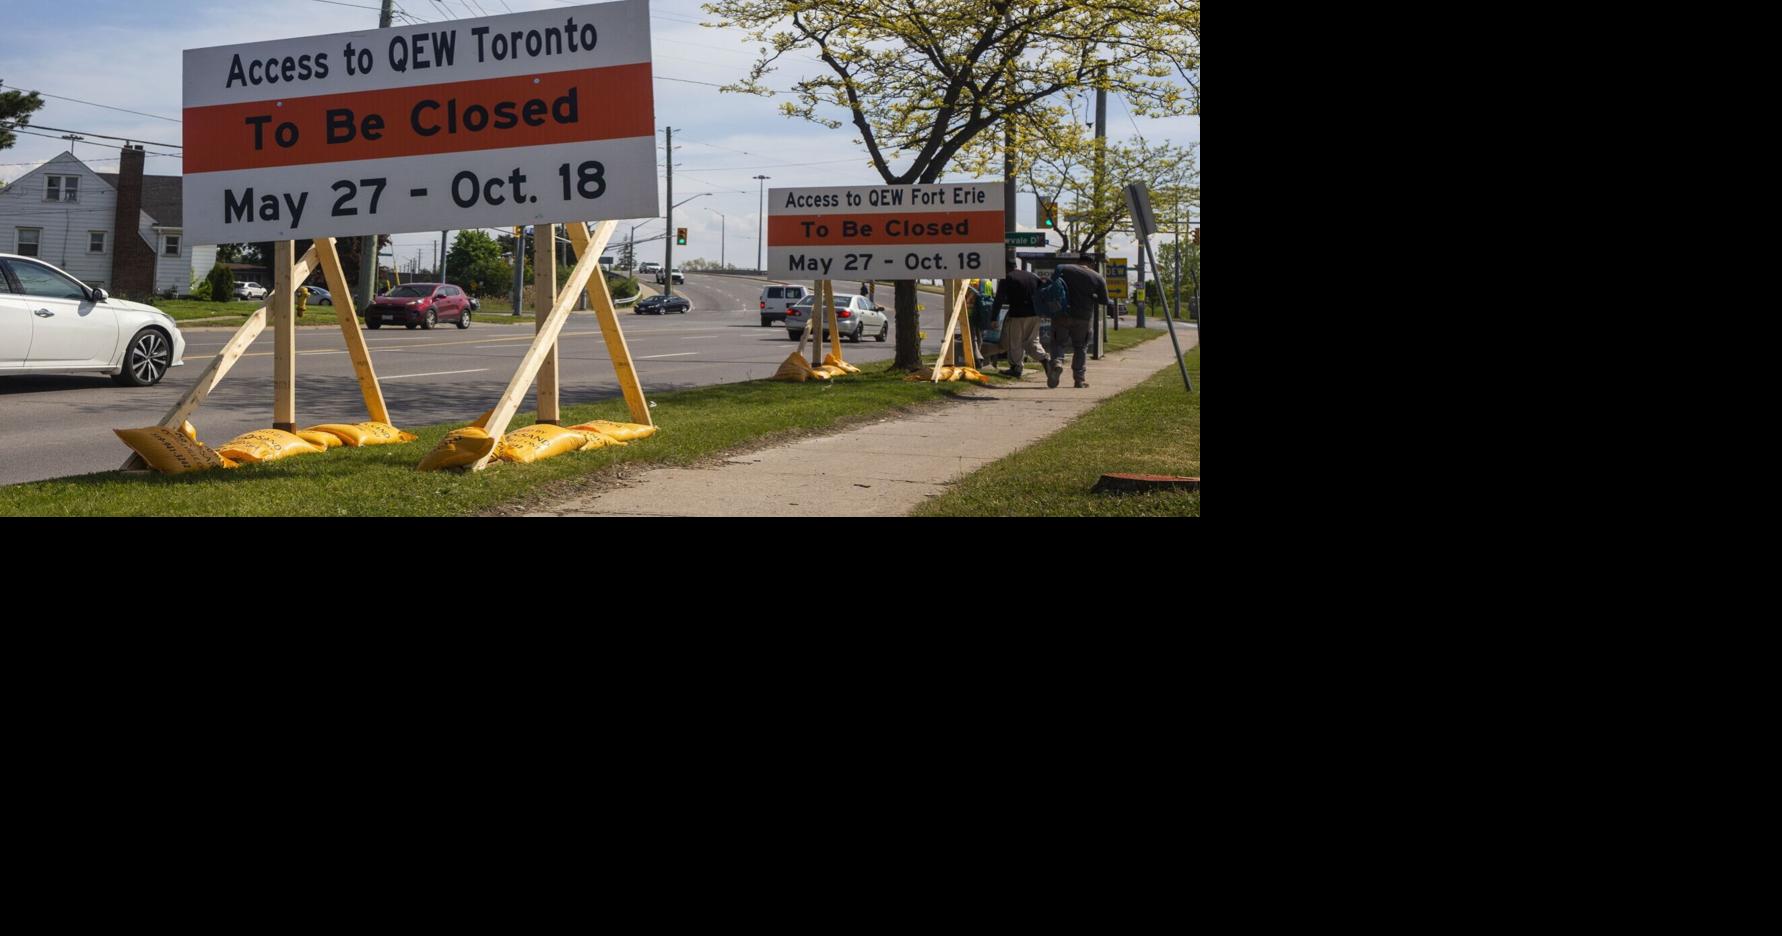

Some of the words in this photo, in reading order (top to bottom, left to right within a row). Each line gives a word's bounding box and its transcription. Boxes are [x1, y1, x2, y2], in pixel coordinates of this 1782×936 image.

[225, 52, 329, 89] Access
[343, 41, 374, 76] to
[388, 29, 457, 74] QEW
[471, 16, 598, 63] Toronto
[245, 115, 301, 152] To
[325, 106, 386, 145] Be
[409, 86, 580, 138] Closed
[224, 187, 309, 230] May
[330, 176, 387, 217] 27
[410, 187, 428, 197] -
[451, 167, 537, 209] Oct.
[559, 160, 606, 201] 18
[785, 191, 839, 208] Access
[846, 190, 862, 207] to
[869, 188, 904, 207] QEW
[911, 188, 945, 205] Fort
[953, 187, 986, 204] Erie
[801, 220, 829, 239] To
[842, 219, 873, 238] Be
[884, 217, 970, 238] Closed
[789, 254, 833, 275] May
[843, 253, 873, 271] 27
[904, 252, 947, 271] Oct.
[957, 251, 982, 270] 18
